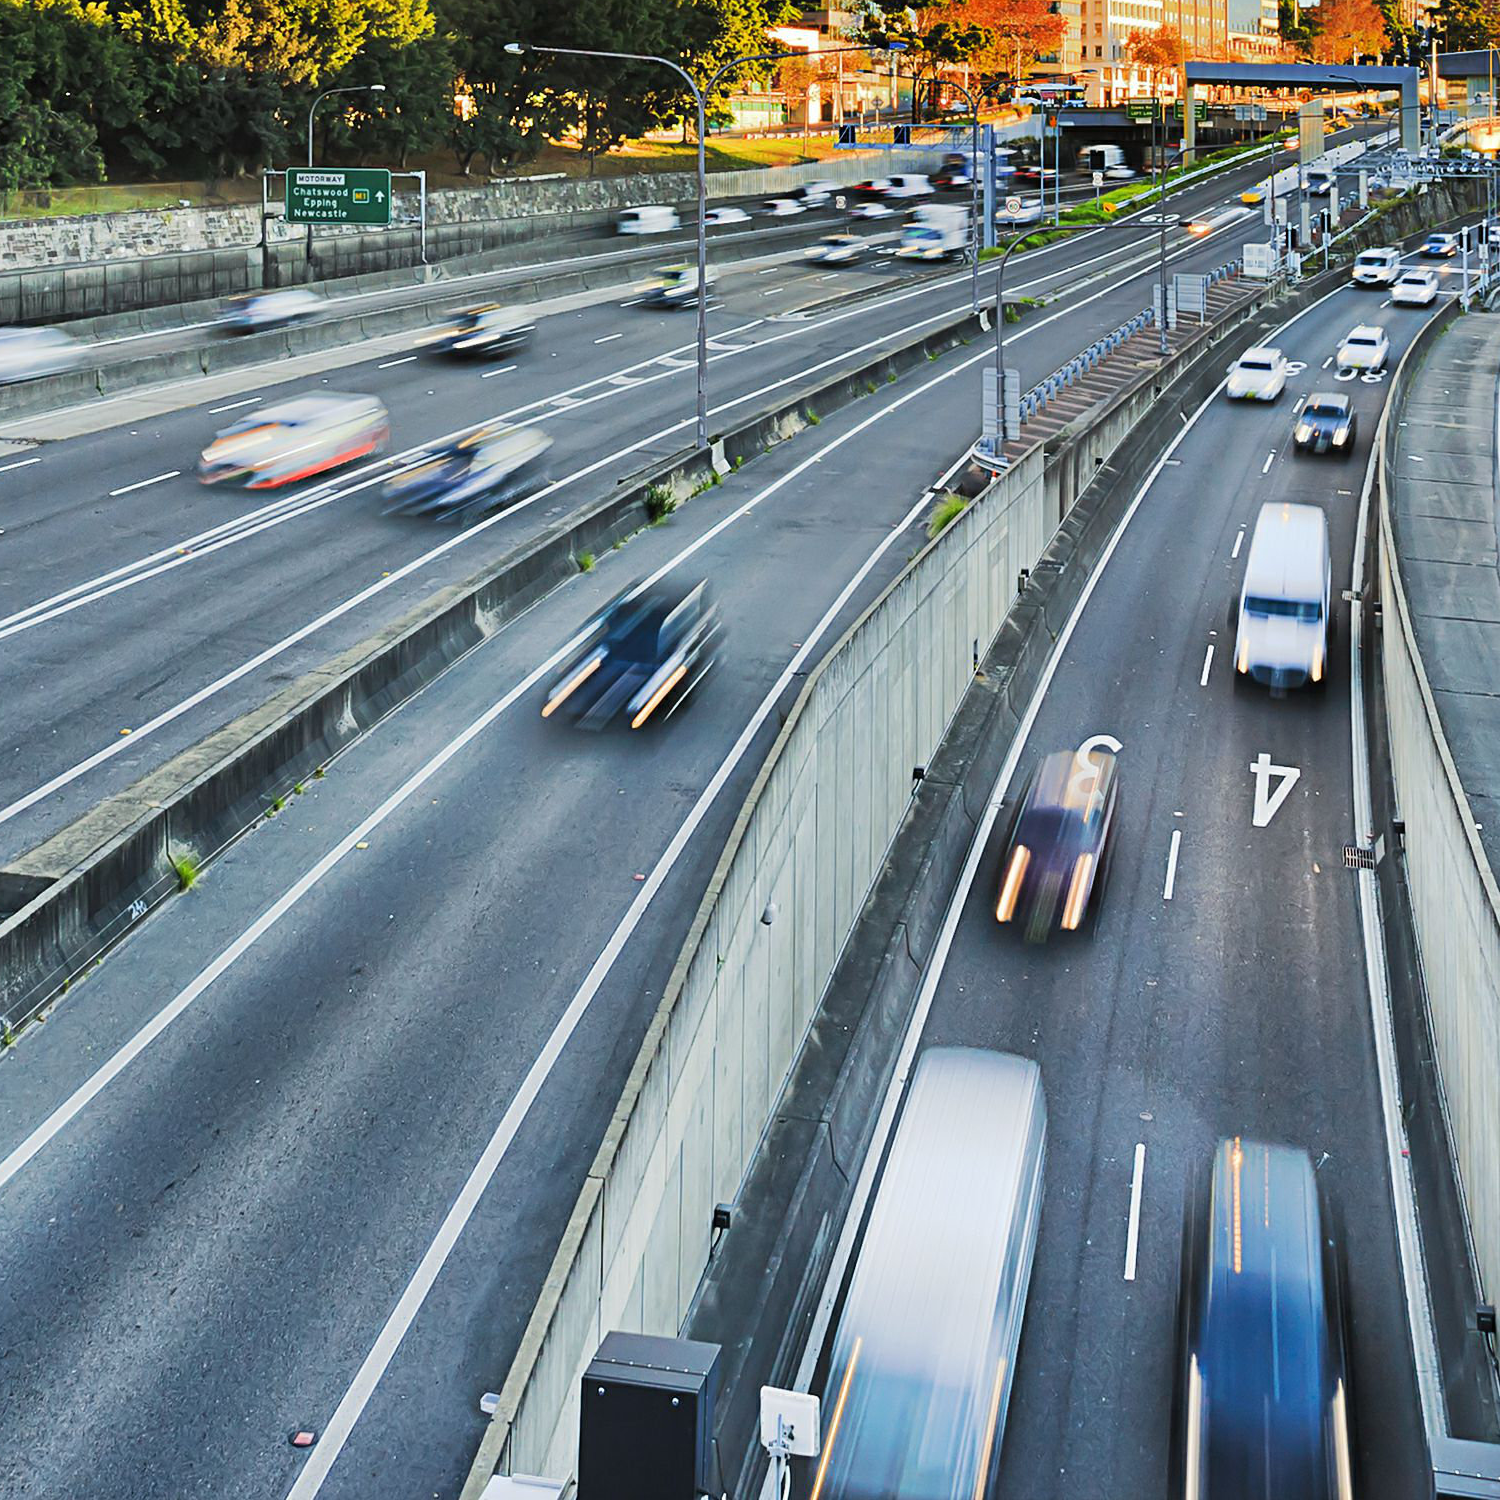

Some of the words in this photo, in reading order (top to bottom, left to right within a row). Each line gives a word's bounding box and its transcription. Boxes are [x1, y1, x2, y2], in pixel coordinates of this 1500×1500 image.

[298, 175, 342, 183] MOTORWAY
[293, 187, 349, 197] Chatswood
[355, 192, 366, 200] M1
[303, 197, 337, 209] Epping
[294, 209, 348, 218] Newcastle
[1139, 213, 1181, 223] 60
[1250, 753, 1301, 828] 4
